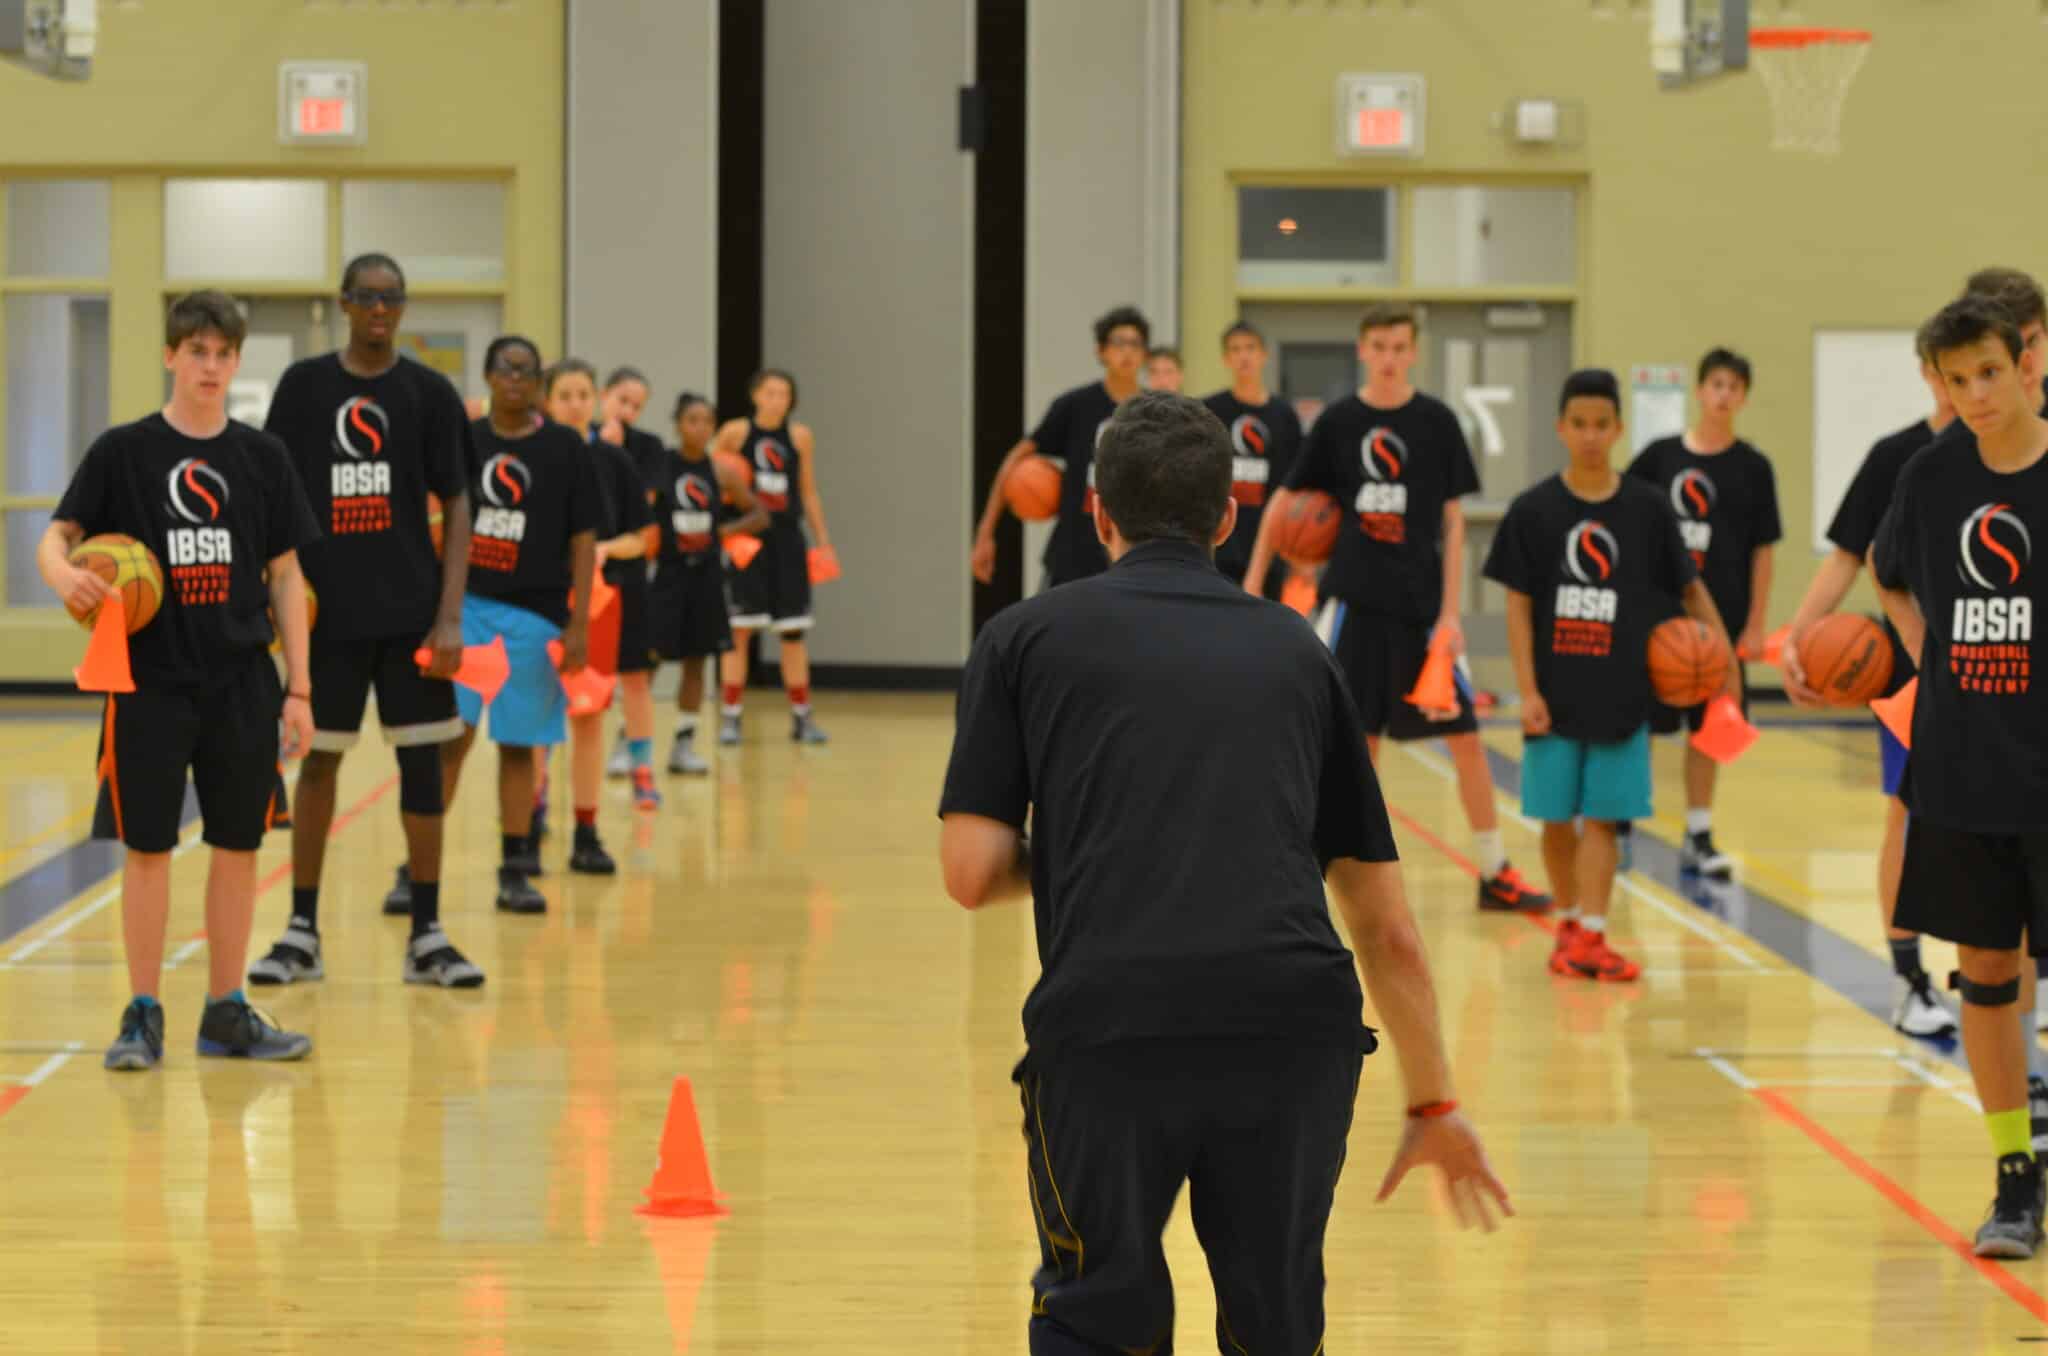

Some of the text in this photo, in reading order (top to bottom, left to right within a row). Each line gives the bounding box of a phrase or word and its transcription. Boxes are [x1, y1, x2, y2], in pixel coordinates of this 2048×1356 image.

[332, 462, 391, 496] IBSA
[168, 528, 232, 565] IBSA
[1555, 585, 1618, 623] IBSA
[1952, 596, 2032, 642] IBSA
